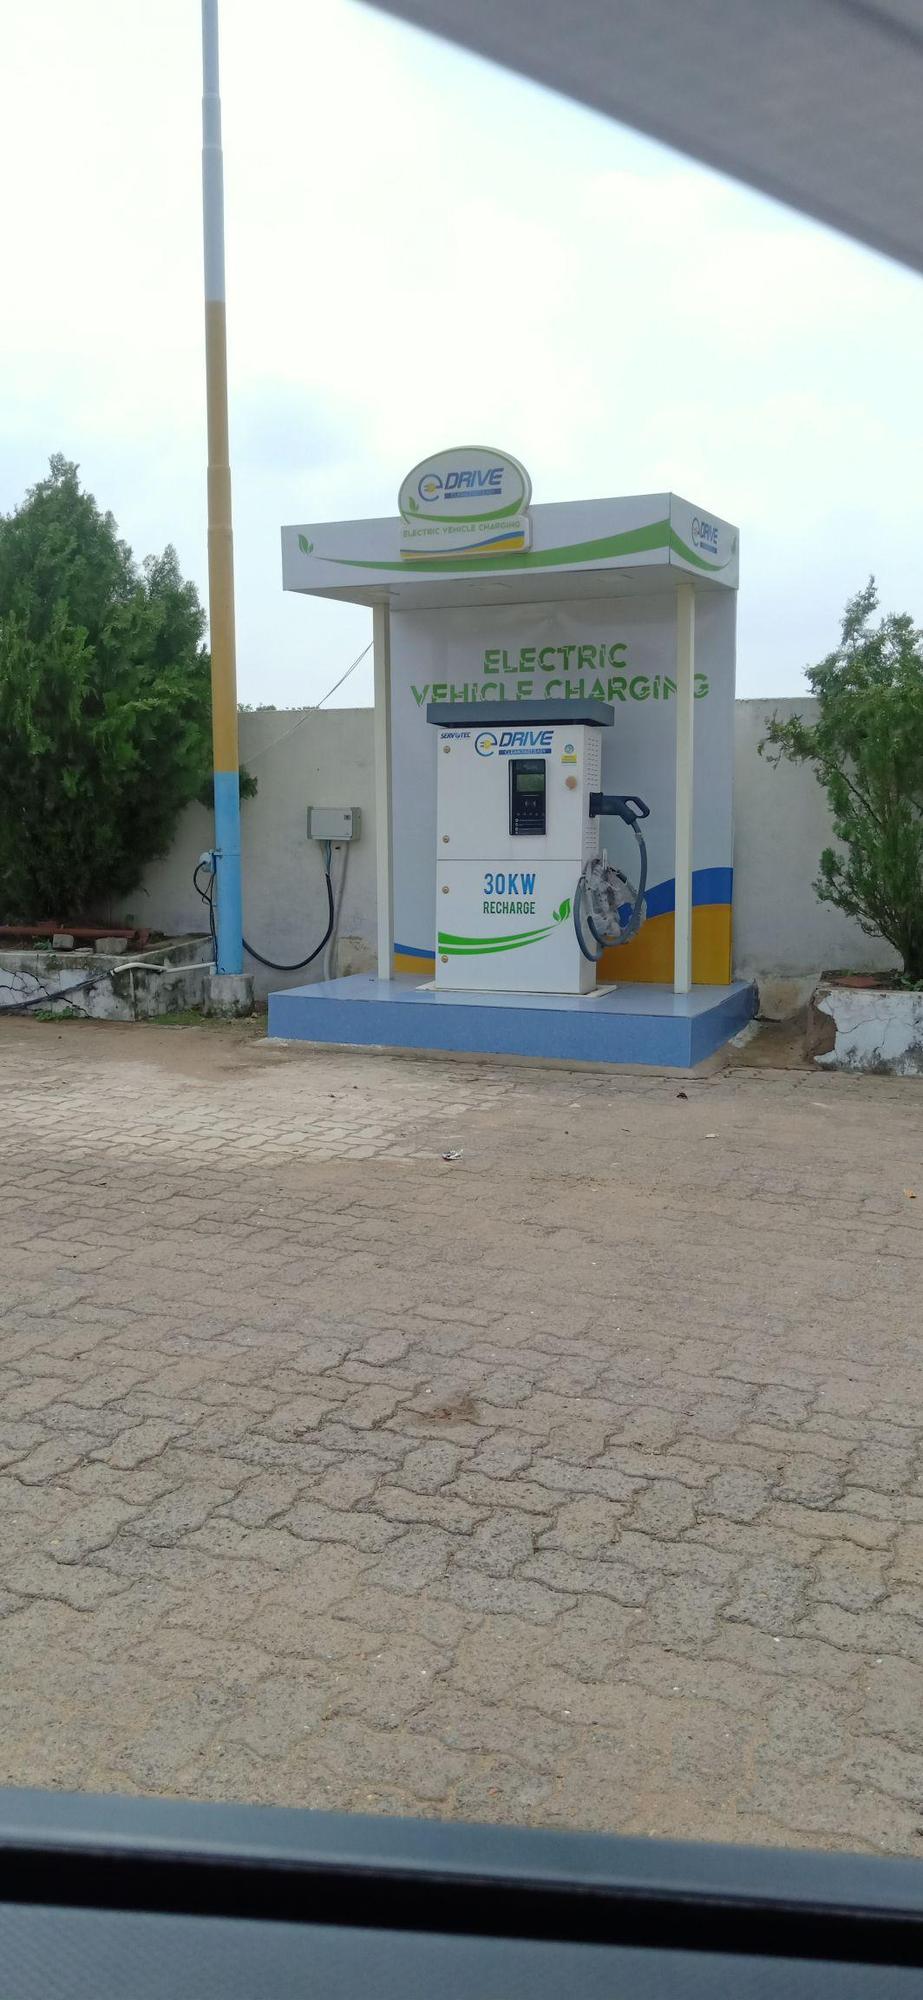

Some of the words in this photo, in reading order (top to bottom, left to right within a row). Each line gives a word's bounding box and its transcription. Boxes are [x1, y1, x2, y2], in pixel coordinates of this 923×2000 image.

[444, 468, 504, 490] DRIVE
[403, 527, 440, 538] ELECTRIC
[443, 524, 477, 534] VEHICLE
[479, 520, 520, 532] CHARGING
[483, 643, 628, 674] ELECTRIC
[410, 680, 534, 707] VEHICLE
[499, 731, 554, 748] DRIVE
[483, 873, 536, 895] 30KW
[483, 901, 536, 914] RECHARGE
